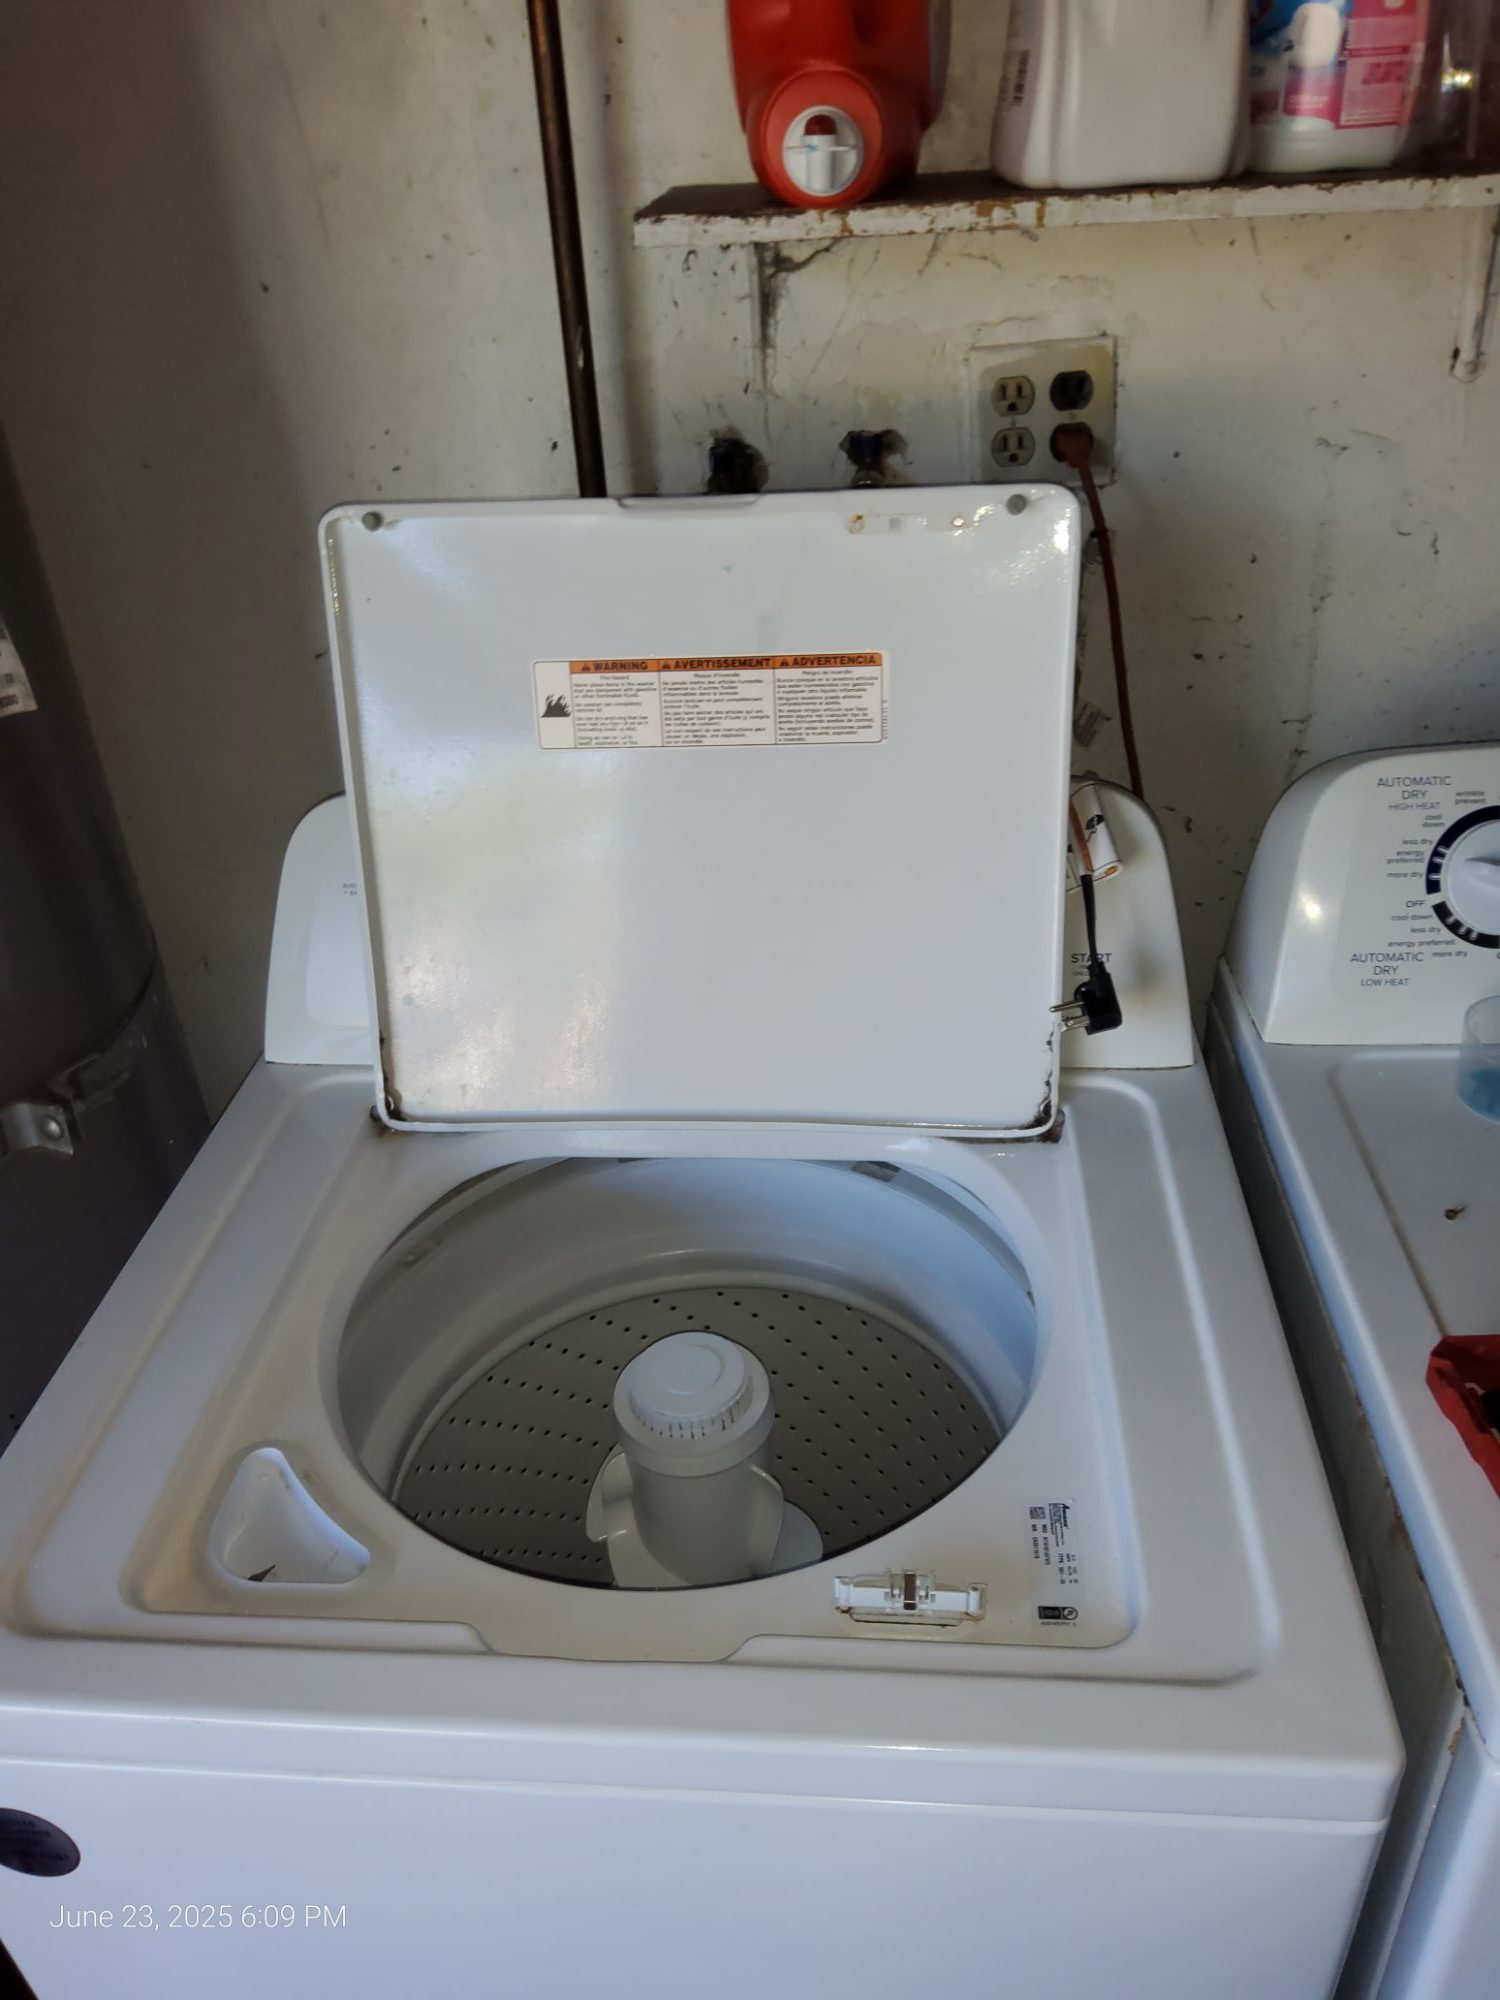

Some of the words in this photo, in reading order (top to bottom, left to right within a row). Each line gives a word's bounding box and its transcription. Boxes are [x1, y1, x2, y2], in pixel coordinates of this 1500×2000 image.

[673, 658, 771, 669] AVERTISSEMENT
[791, 655, 876, 666] ADVERTENCIA
[592, 662, 648, 671] WARNING
[1377, 775, 1452, 788] AUTOMATIC
[1402, 789, 1428, 800] DRY
[1388, 802, 1414, 811] HIGH
[1415, 801, 1440, 810] HEAT
[1420, 838, 1433, 847] dry
[1409, 870, 1424, 879] dry
[1405, 900, 1427, 908] OFF
[1410, 926, 1427, 934] less
[1428, 926, 1442, 935] dry
[1350, 951, 1424, 963] AUTOMATIC
[1454, 950, 1468, 959] dry
[1373, 965, 1400, 976] DRY
[1360, 978, 1384, 987] LOW
[1384, 978, 1411, 987] HEAT
